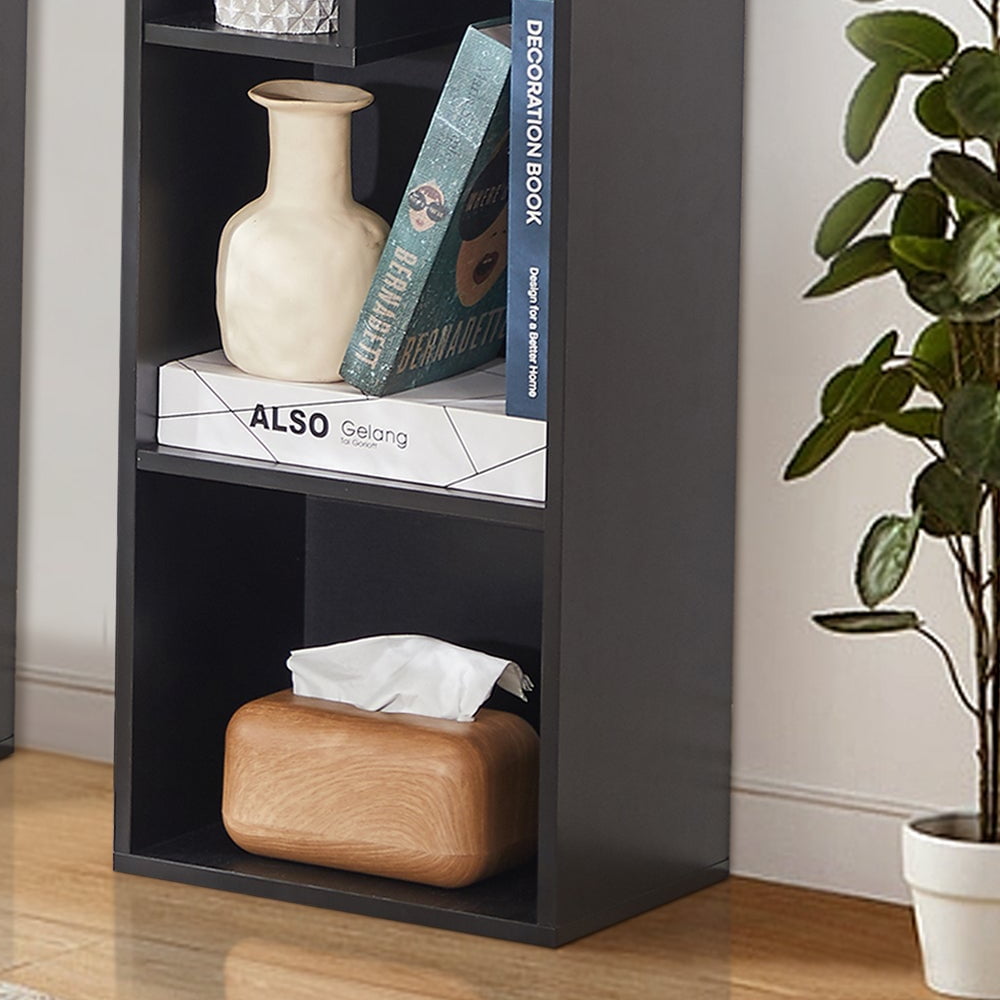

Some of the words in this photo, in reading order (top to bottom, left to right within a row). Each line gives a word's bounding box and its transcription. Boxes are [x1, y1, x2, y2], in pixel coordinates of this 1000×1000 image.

[526, 19, 543, 157] DECORATION
[526, 162, 542, 226] BOOK
[527, 267, 539, 303] Design
[529, 305, 539, 321] for
[529, 332, 539, 364] Better
[528, 365, 538, 398] Home
[249, 403, 330, 439] ALSO
[341, 420, 408, 450] Gelang
